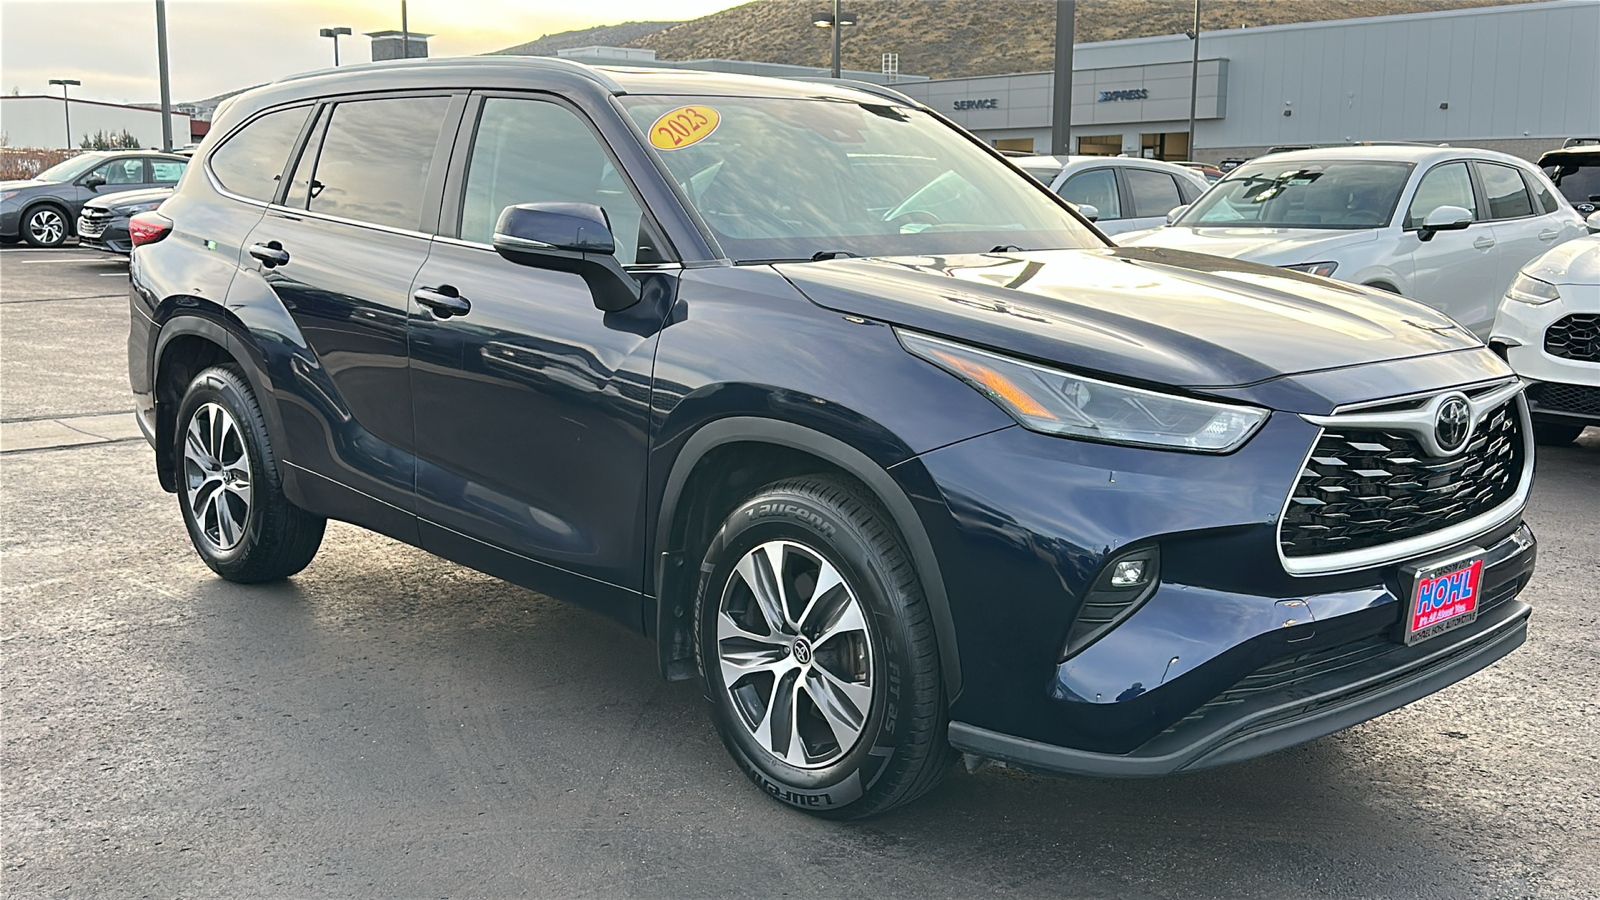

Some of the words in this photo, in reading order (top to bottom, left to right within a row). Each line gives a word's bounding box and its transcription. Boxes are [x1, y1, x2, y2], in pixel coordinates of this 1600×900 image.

[953, 98, 998, 110] SERVICE
[658, 108, 708, 146] 2023
[1416, 570, 1471, 615] HOHL
[1409, 628, 1431, 643] MICHAEL
[1432, 625, 1444, 634] HOHL
[1444, 612, 1476, 629] AUTOMOTIVE
